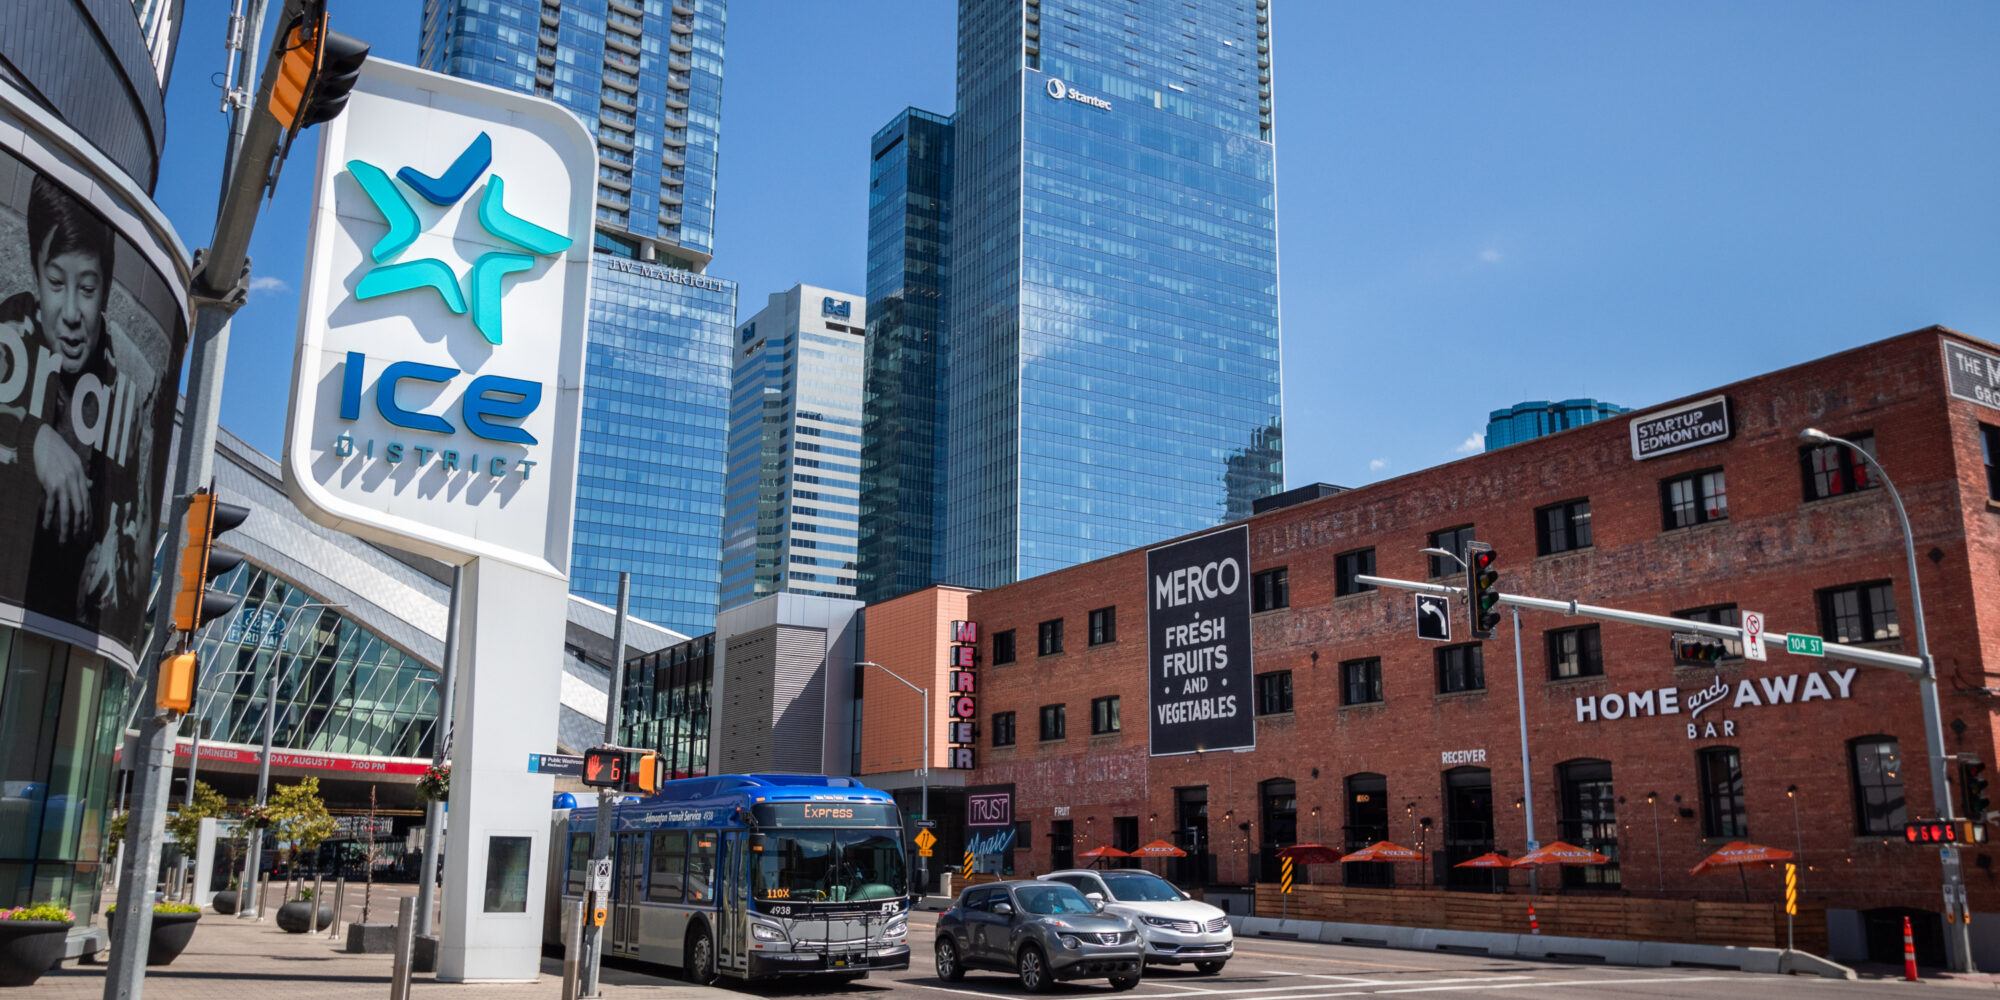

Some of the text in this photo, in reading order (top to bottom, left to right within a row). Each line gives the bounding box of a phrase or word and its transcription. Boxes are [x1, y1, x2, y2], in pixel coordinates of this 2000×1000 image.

[1068, 88, 1112, 111] Stantec
[609, 259, 724, 292] JW MARRIOTT
[824, 296, 851, 317] Bell
[1955, 352, 1983, 377] THE
[340, 351, 543, 445] ICE
[71, 372, 137, 467] all
[1639, 411, 1703, 438] STARTUP
[1641, 419, 1723, 452] EDMONTON
[336, 435, 538, 480] DISTRICT
[1156, 557, 1240, 610] MERCO
[1165, 616, 1226, 649] FRESH
[1791, 637, 1820, 652] 104 ST
[1163, 644, 1228, 678] FRUITS
[957, 620, 977, 769] MERCER
[1182, 676, 1209, 695] AND
[1575, 668, 1857, 723] HOME and AWAY
[1157, 695, 1237, 725] VEGETABLES
[1687, 720, 1736, 740] BAR
[198, 746, 238, 760] UMINEERS
[254, 753, 292, 766] SDAY,
[293, 756, 328, 767] AUGUST
[329, 758, 336, 767] 7
[351, 761, 370, 770] 7:00
[371, 762, 386, 771] PM
[611, 758, 620, 780] 6
[1441, 749, 1487, 764] RECEIVER
[645, 812, 667, 822] Edmonton
[668, 811, 684, 822] Transit
[684, 810, 702, 821] Service
[804, 803, 853, 818] Express
[971, 798, 1008, 821] TRUST
[1054, 806, 1070, 817] FRUIT
[966, 827, 1016, 855] Magic
[767, 888, 790, 898] 110X
[769, 906, 791, 915] 4938
[881, 902, 899, 912] ETS
